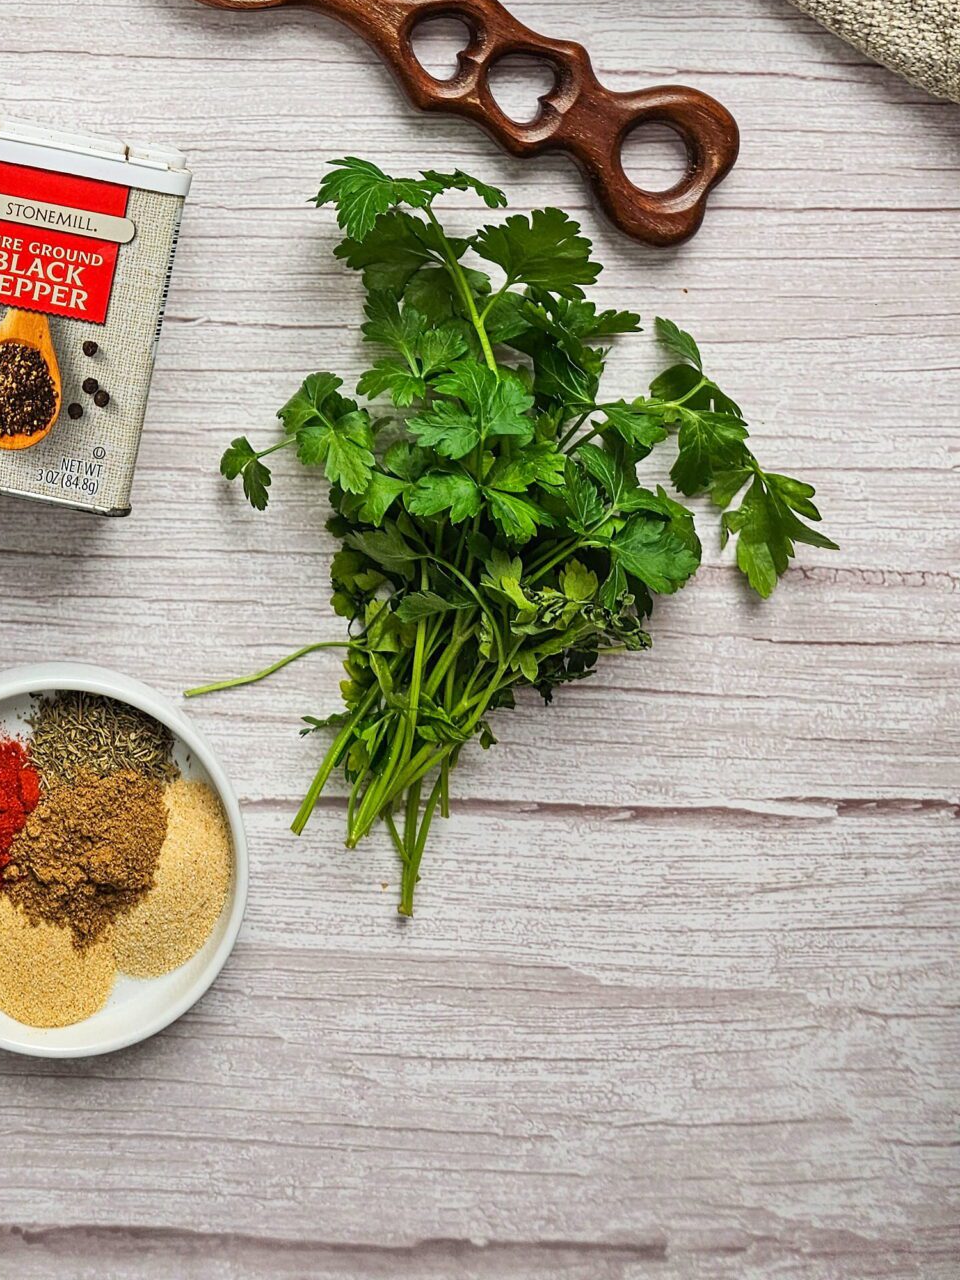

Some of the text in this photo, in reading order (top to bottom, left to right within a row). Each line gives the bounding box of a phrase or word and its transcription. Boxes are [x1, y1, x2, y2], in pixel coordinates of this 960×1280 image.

[28, 242, 104, 267] GROUND
[61, 458, 103, 477] NET WT
[36, 469, 99, 495] 3 OZ (84.8g)
